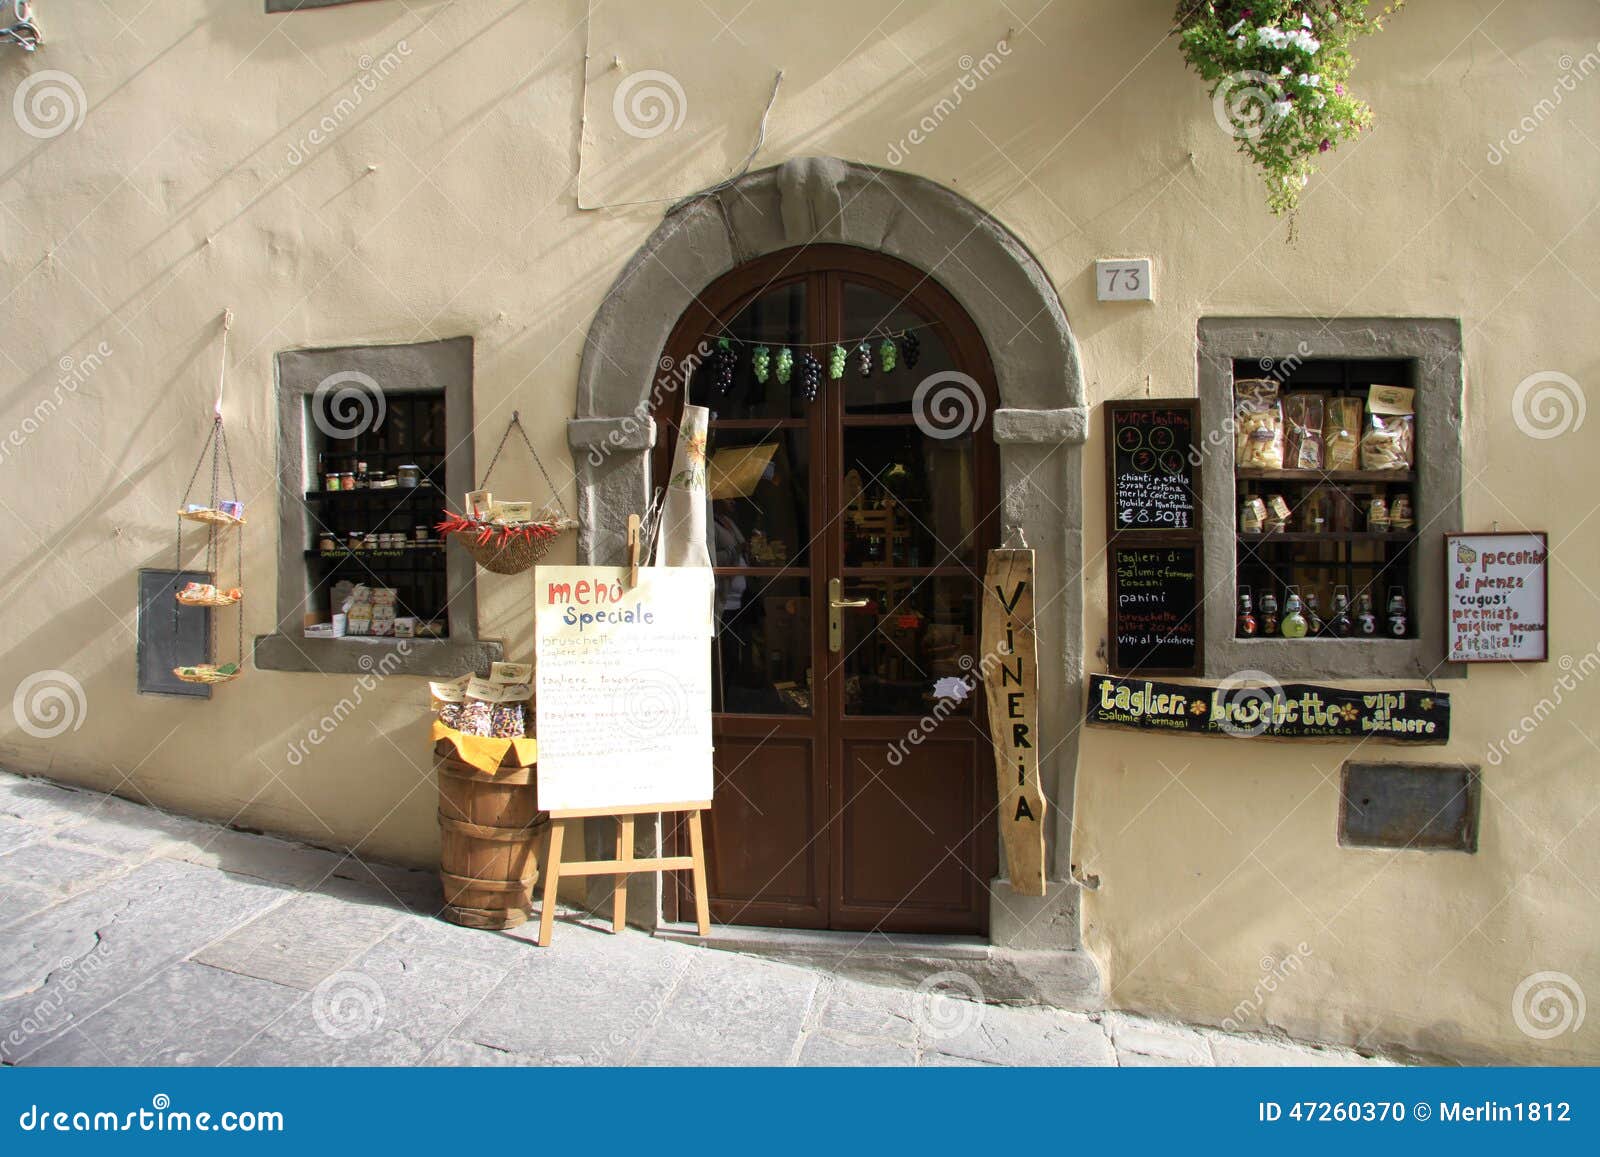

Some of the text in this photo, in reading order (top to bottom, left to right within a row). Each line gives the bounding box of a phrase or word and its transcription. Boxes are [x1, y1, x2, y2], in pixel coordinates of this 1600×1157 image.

[1105, 268, 1140, 292] 73
[1455, 572, 1471, 588] di
[1119, 591, 1166, 607] panini
